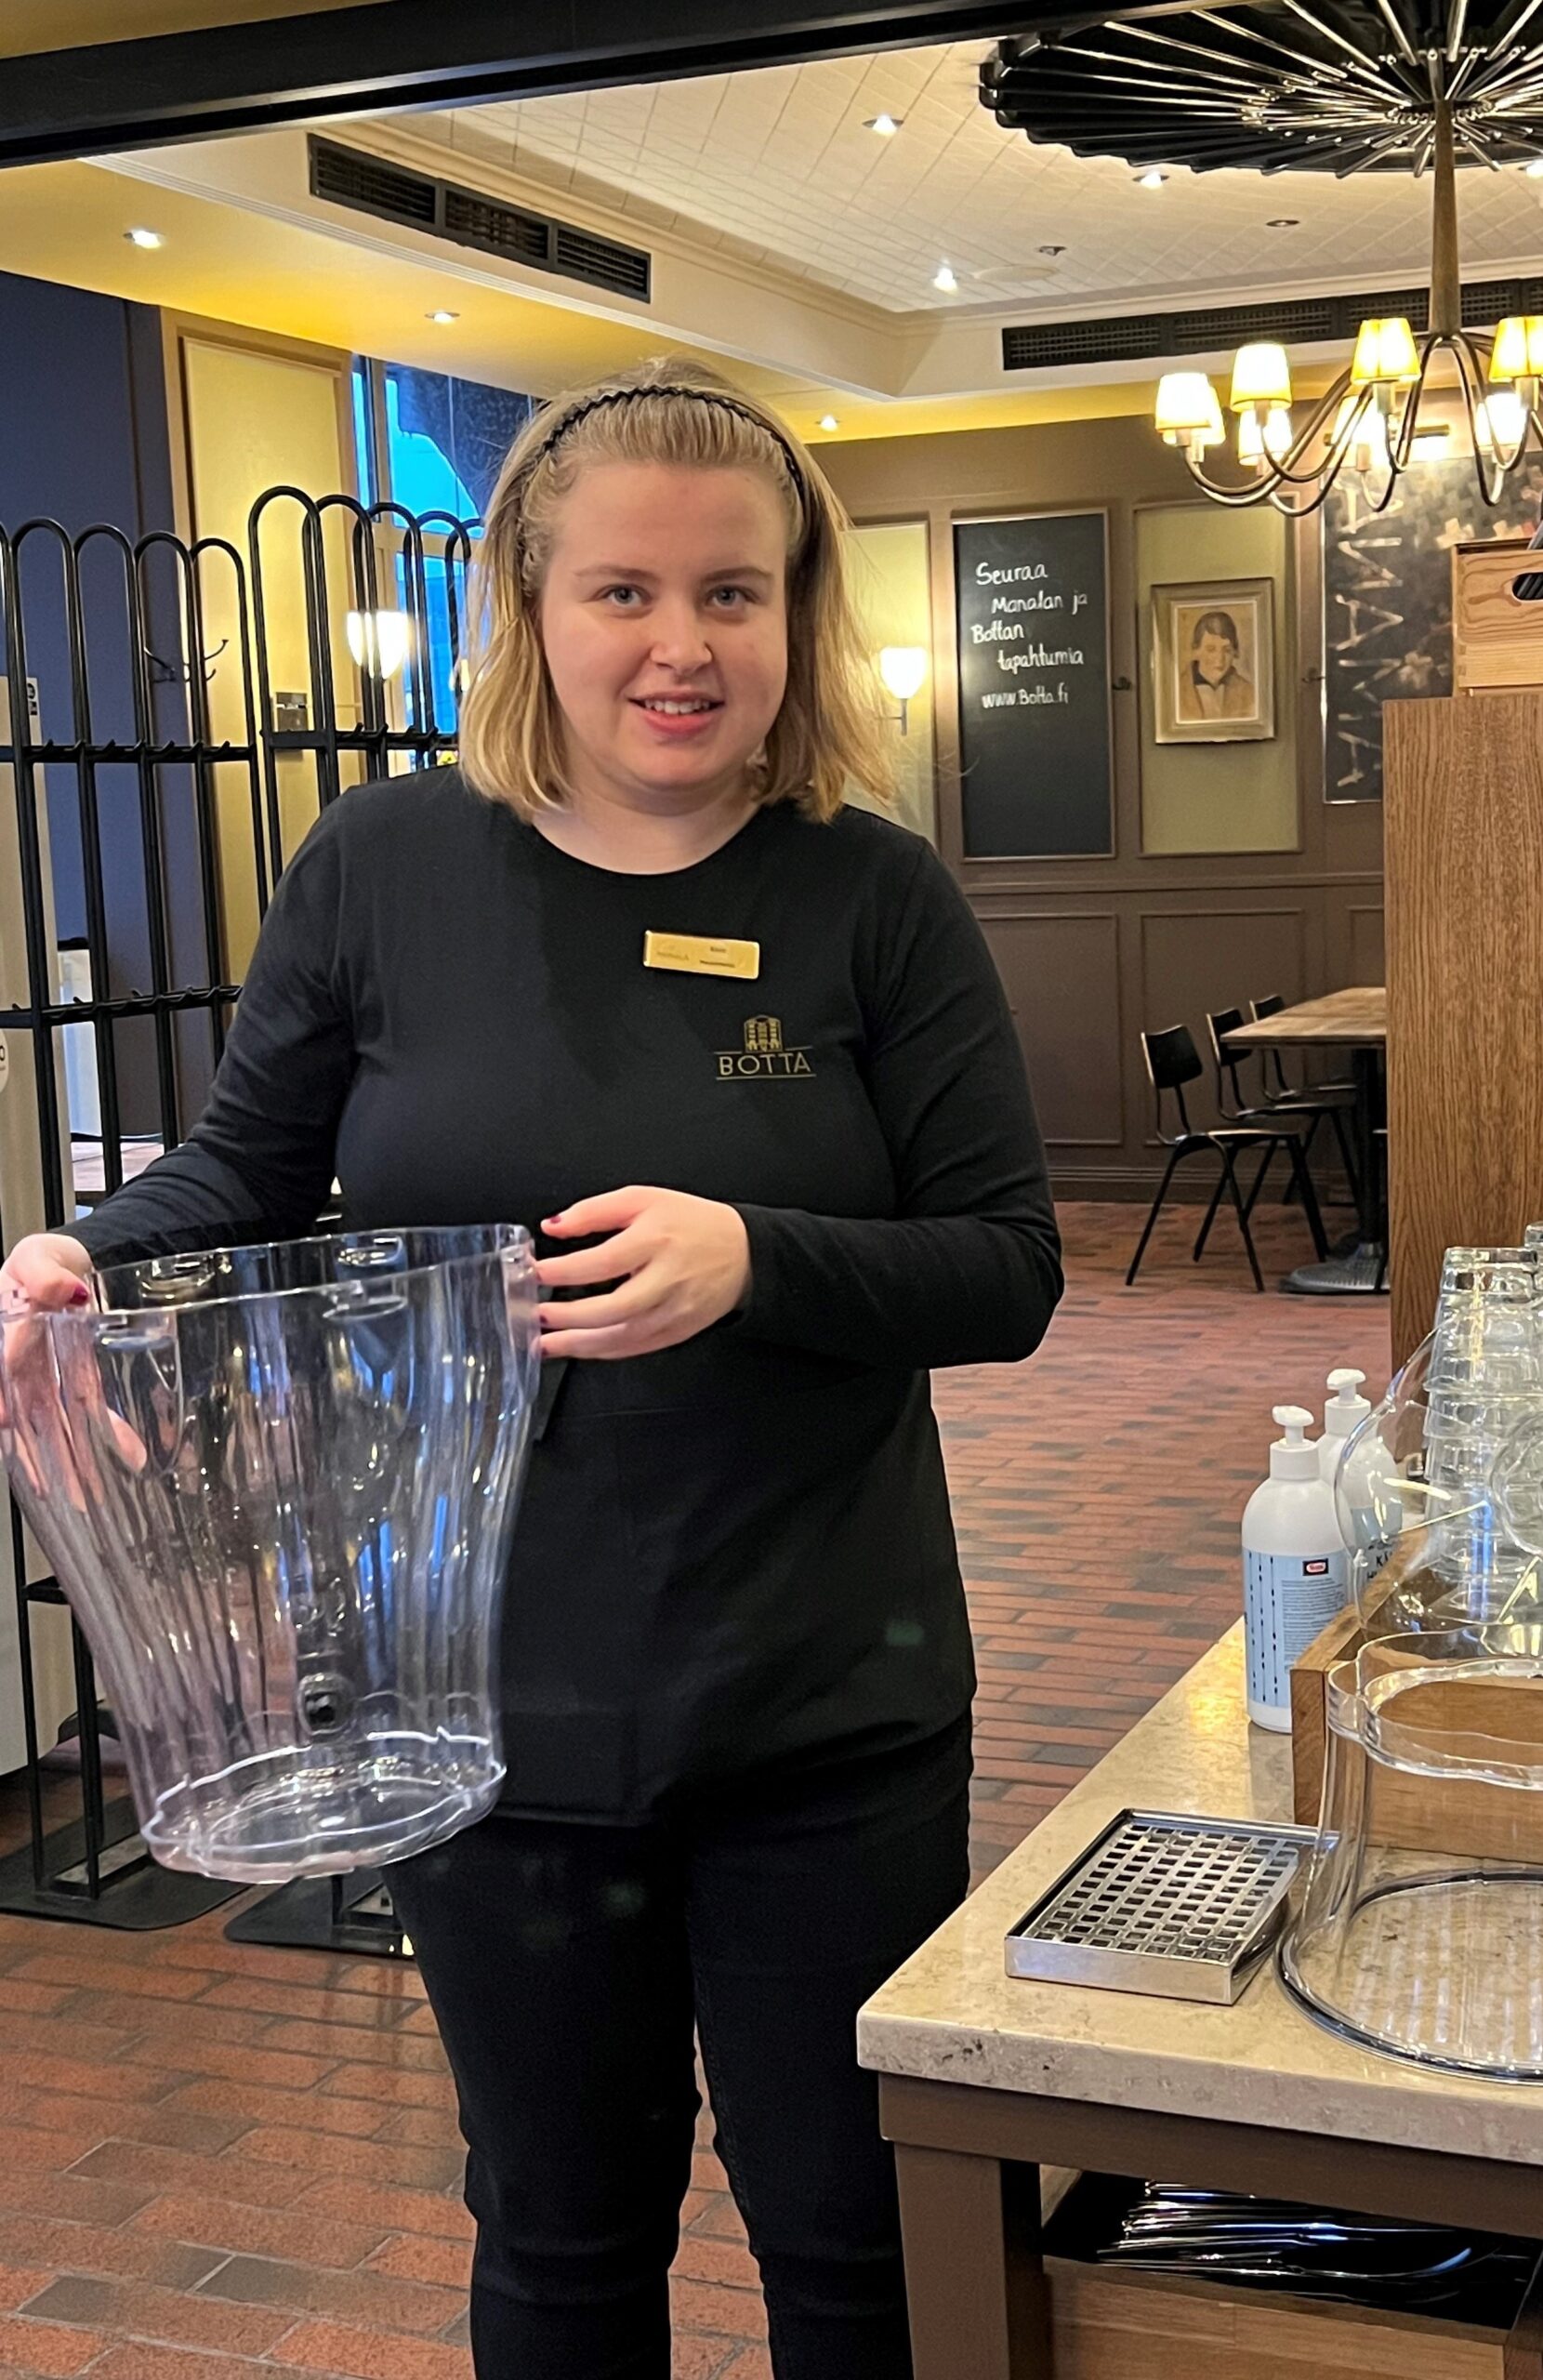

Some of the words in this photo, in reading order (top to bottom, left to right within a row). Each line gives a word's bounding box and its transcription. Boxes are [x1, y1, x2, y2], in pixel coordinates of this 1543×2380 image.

[976, 562, 1048, 585] Seuraa
[991, 589, 1063, 614] Manalan
[1072, 589, 1088, 615] ja
[970, 620, 1024, 644] Bottan
[997, 642, 1085, 675] tapahtumia
[719, 1051, 811, 1077] BOTTA
